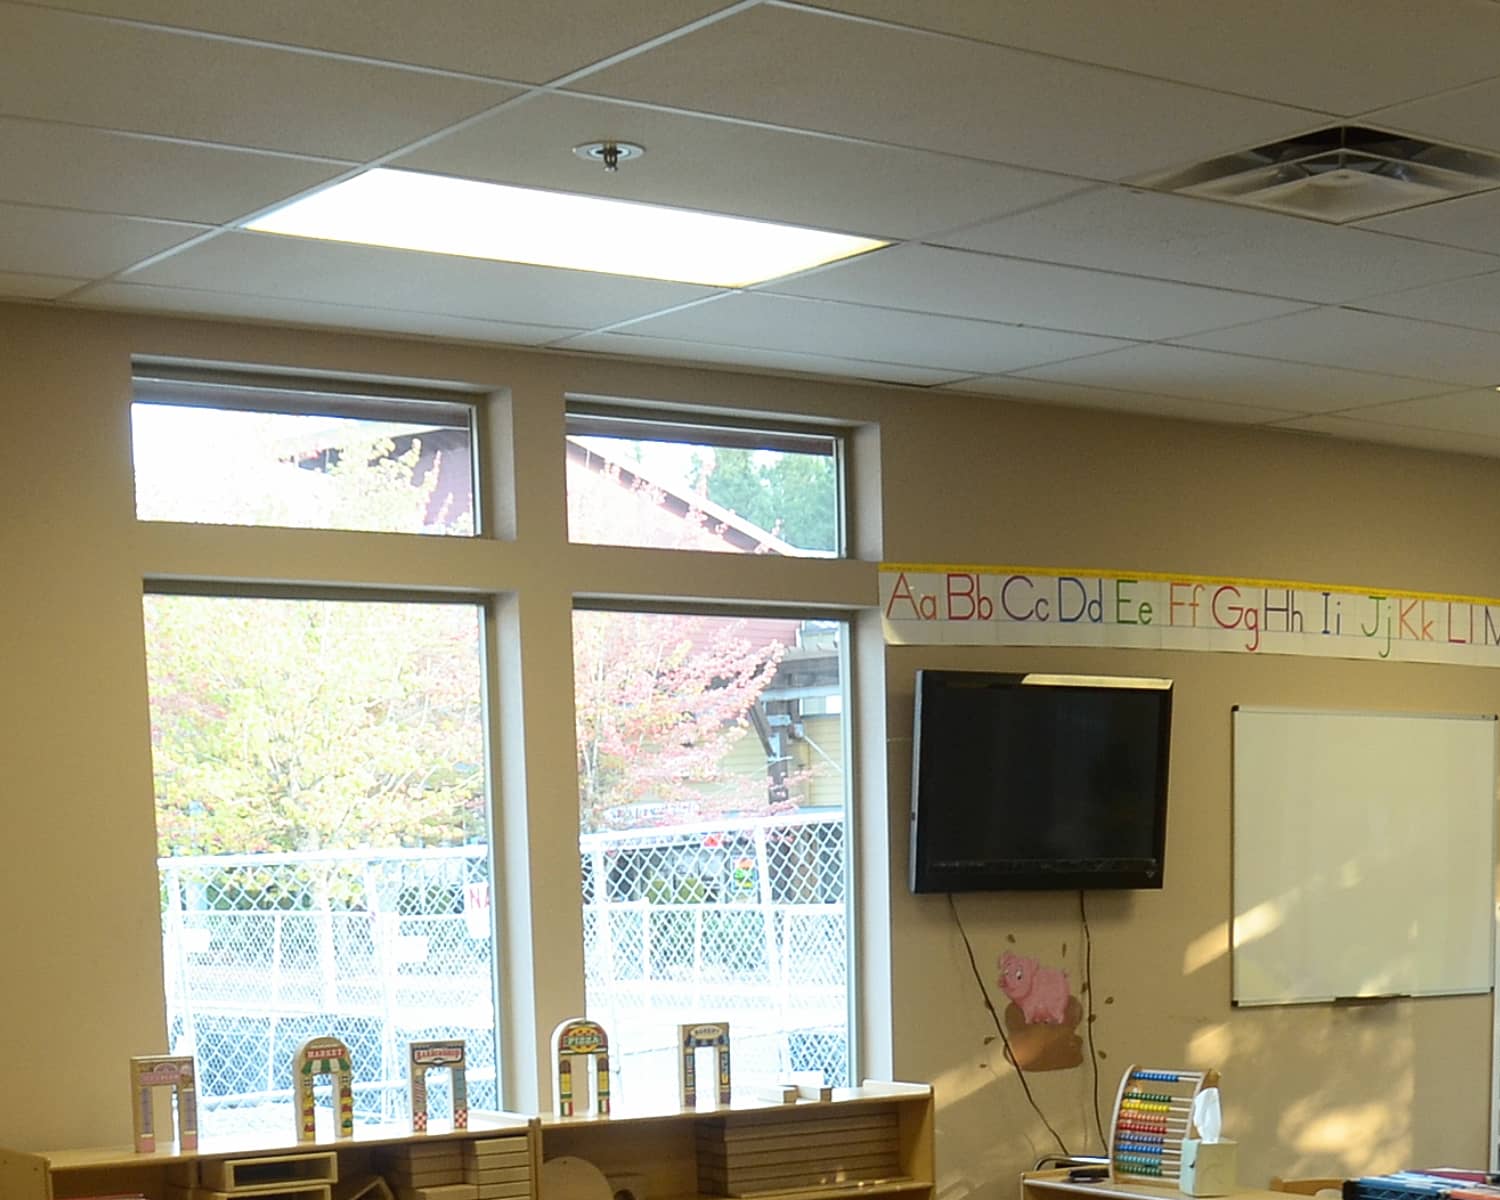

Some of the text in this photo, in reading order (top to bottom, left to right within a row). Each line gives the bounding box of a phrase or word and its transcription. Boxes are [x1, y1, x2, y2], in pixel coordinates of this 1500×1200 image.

[886, 573, 937, 620] Aa
[946, 574, 993, 621] Bb
[1001, 575, 1049, 622] Cc
[1058, 577, 1102, 624] Dd
[1115, 580, 1153, 626] Ee
[1168, 583, 1205, 627] Ff
[1211, 585, 1259, 652] Gg
[1264, 588, 1303, 633] Hh
[1320, 592, 1341, 635] Ii
[1360, 595, 1392, 658] Jj
[1398, 599, 1434, 642] Kk
[1447, 602, 1474, 644] Ll
[567, 1036, 600, 1047] PIZZA
[308, 1049, 343, 1059] MARKET
